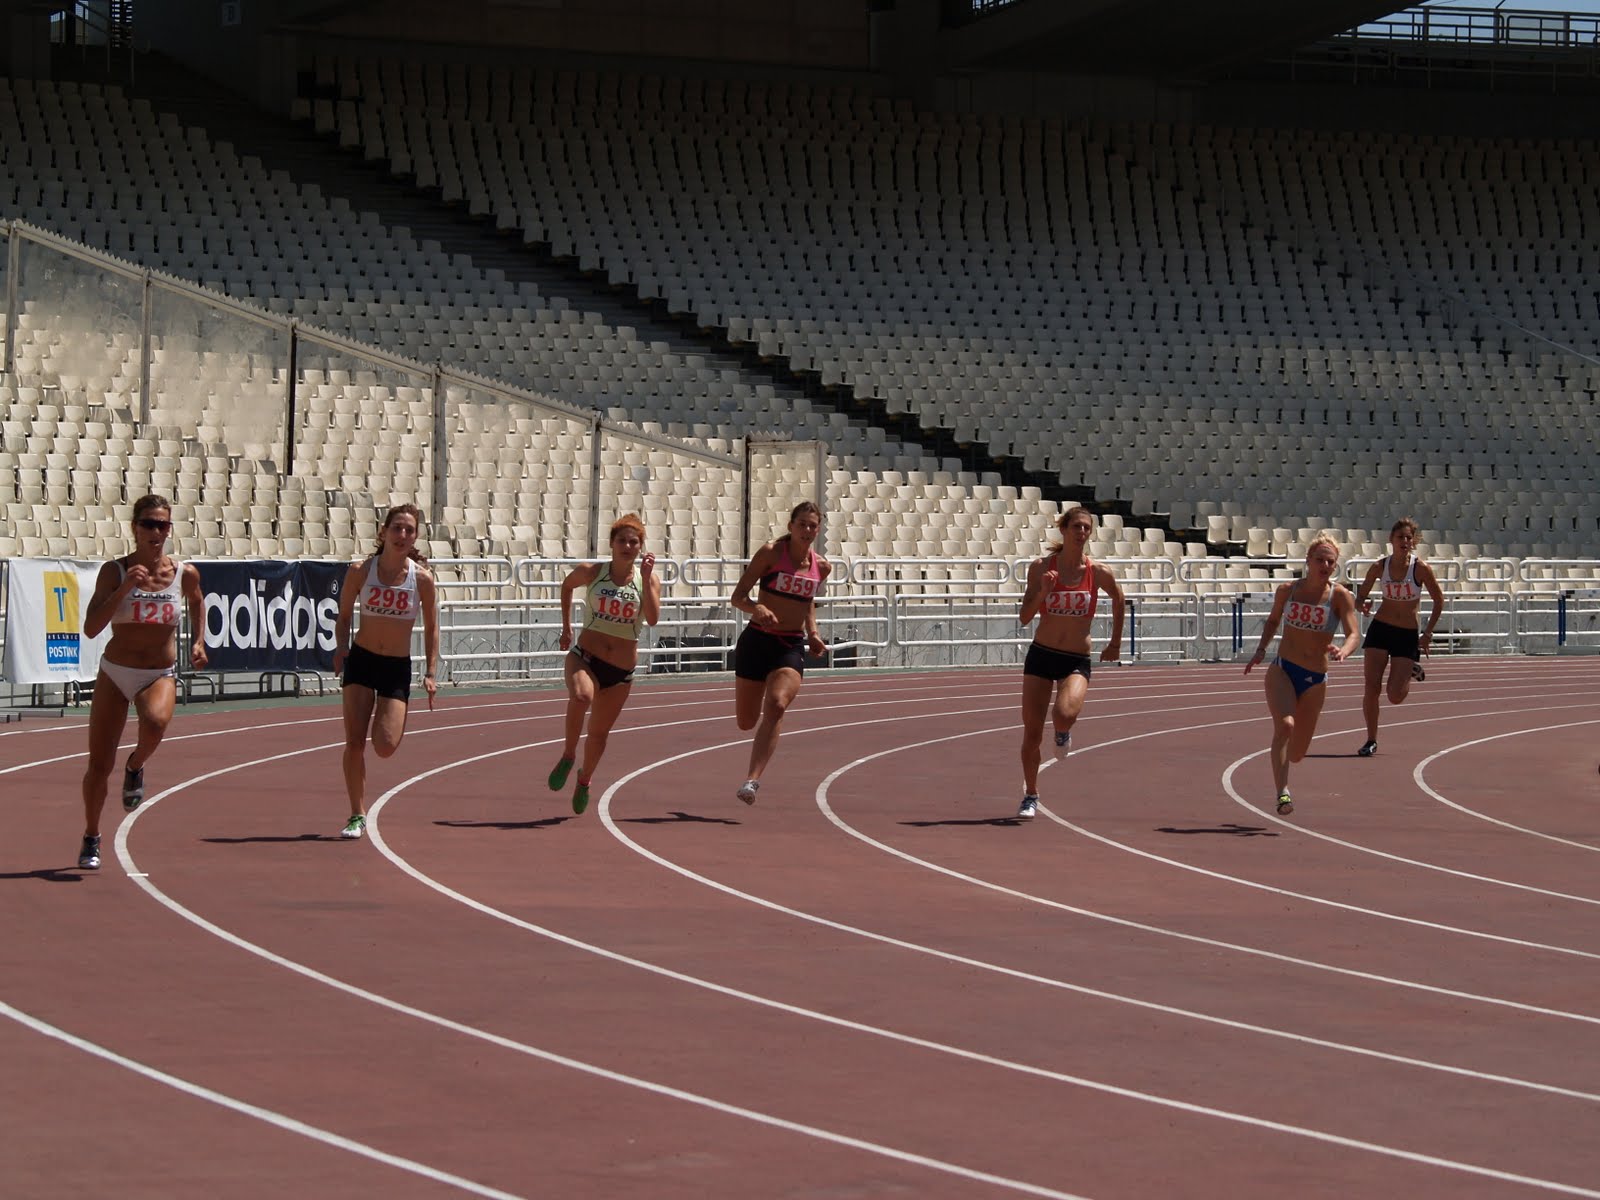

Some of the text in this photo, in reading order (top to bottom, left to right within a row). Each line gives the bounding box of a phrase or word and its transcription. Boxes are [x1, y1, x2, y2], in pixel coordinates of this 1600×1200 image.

[601, 588, 635, 600] adidas
[780, 575, 814, 596] 359
[1385, 583, 1412, 597] 171
[367, 586, 409, 611] 298
[598, 597, 634, 618] 186
[1049, 592, 1086, 609] 212
[131, 601, 174, 623] 128
[204, 578, 339, 651] adidas
[1288, 602, 1325, 625] 383
[48, 646, 78, 658] POSTNK
